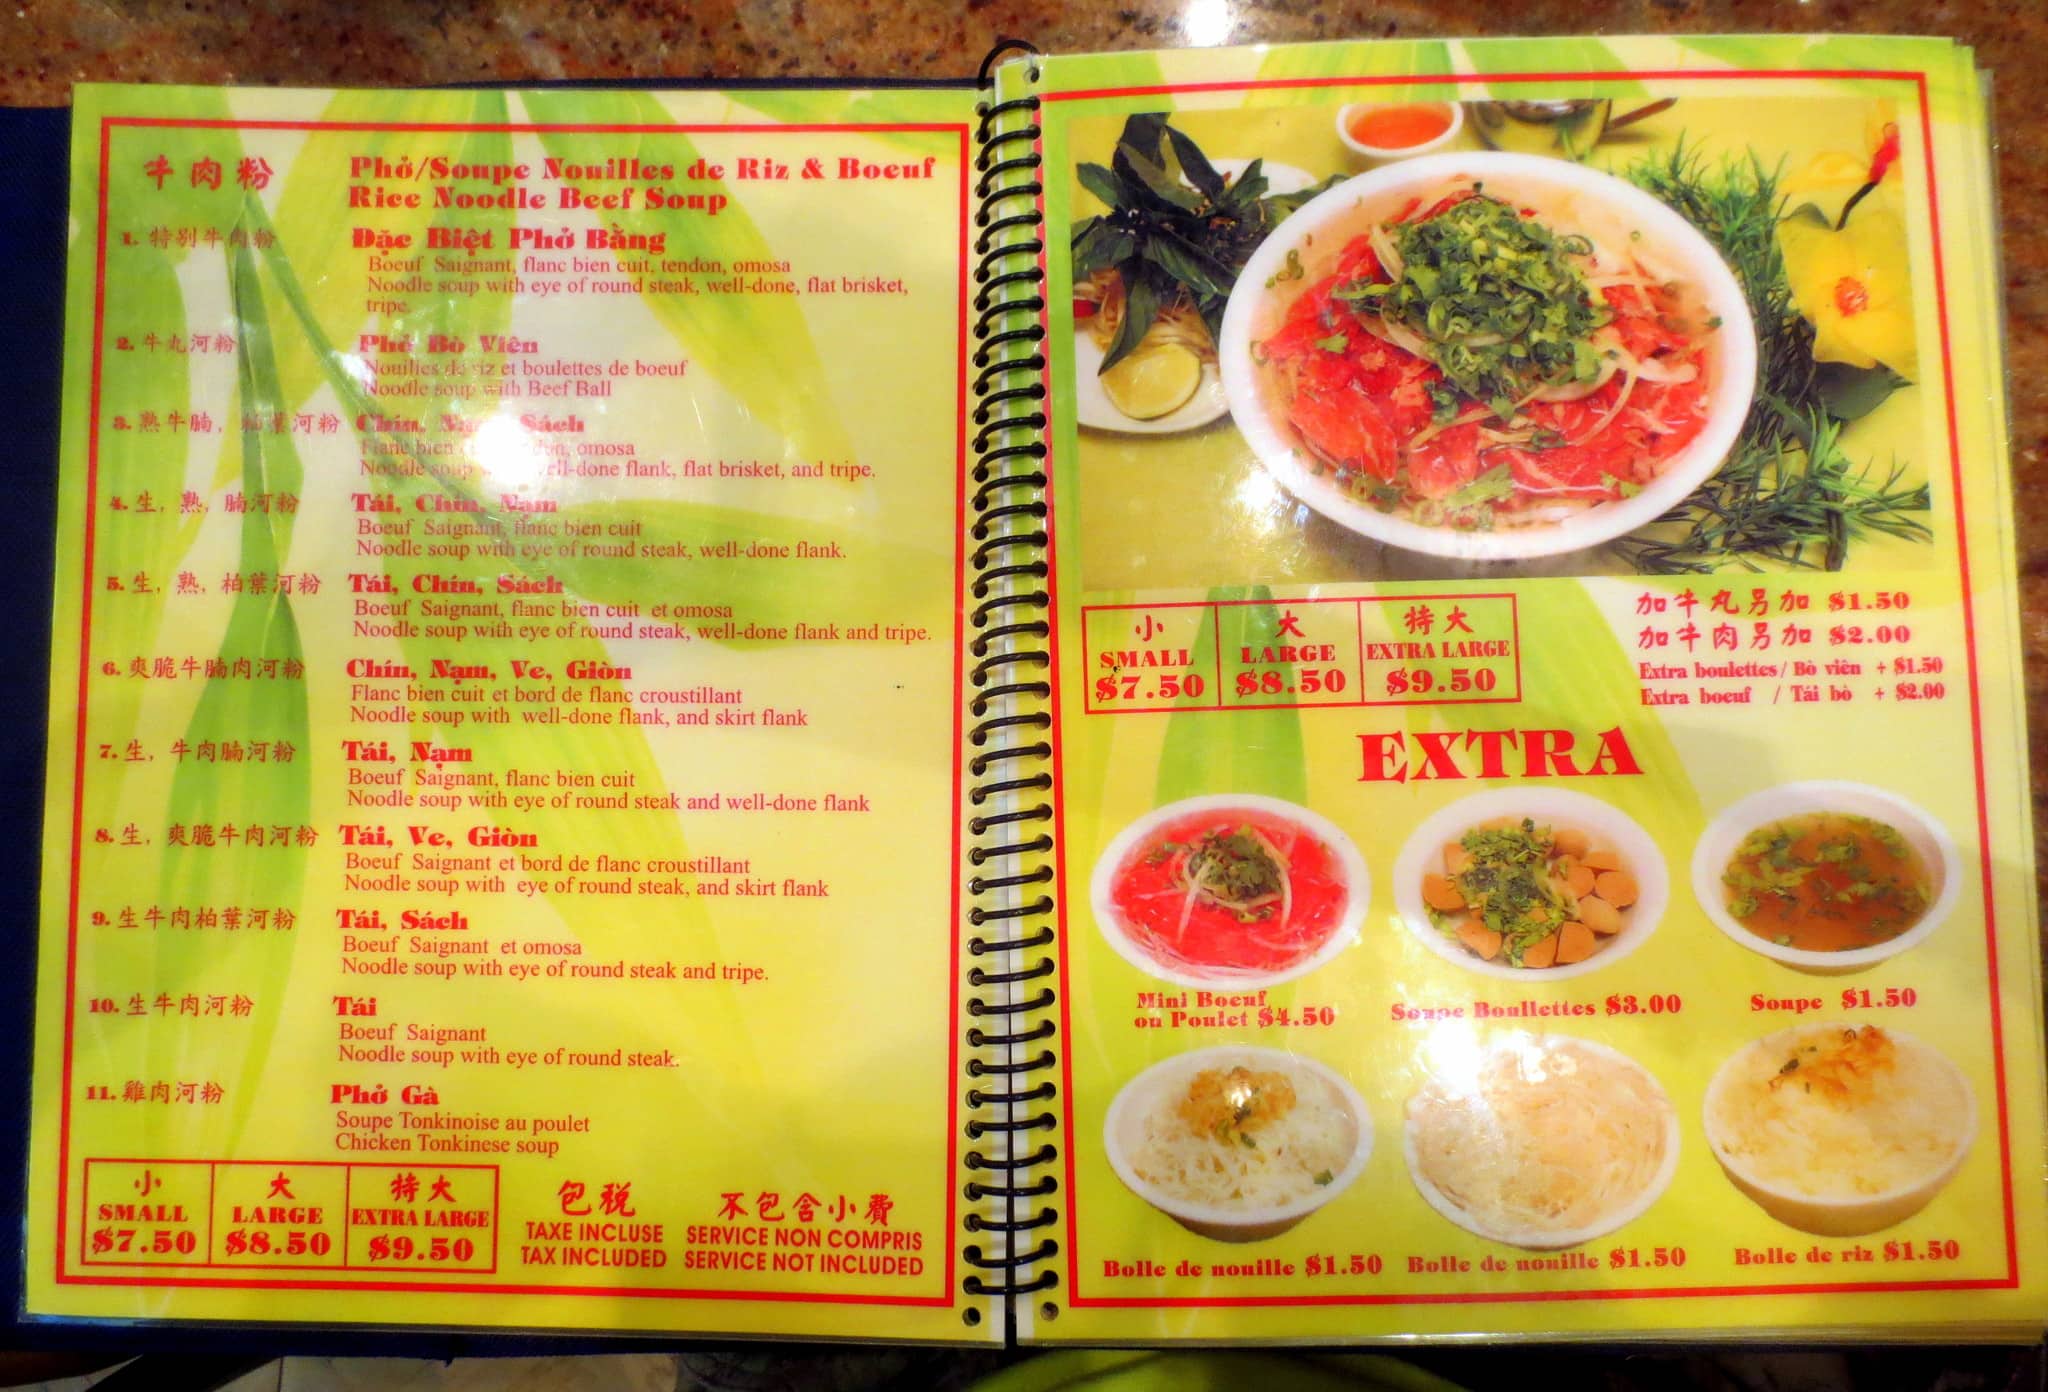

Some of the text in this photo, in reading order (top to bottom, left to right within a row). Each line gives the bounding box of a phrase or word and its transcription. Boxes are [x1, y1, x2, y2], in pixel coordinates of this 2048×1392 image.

[144, 154, 274, 191] 牛肉粉
[542, 157, 674, 181] Nouilles
[688, 158, 725, 180] de
[736, 157, 790, 180] Riz
[801, 158, 824, 179] &
[837, 157, 936, 180] Boeuf
[349, 186, 727, 216] Rice Noodle Beef Soup
[369, 256, 424, 273] Boeuf
[524, 256, 567, 273] flanc
[573, 256, 610, 273] bien
[661, 257, 727, 276] tendon,
[733, 261, 791, 274] omosa
[349, 573, 563, 595] Tái, Chín, Sách
[1828, 591, 1910, 610] $1.50
[1135, 614, 1163, 641] 小
[1275, 610, 1306, 638] 大
[1829, 625, 1911, 645] $2.00
[1100, 648, 1194, 669] SMALL
[1241, 645, 1336, 664] LARGE
[1367, 639, 1510, 661] EXTRA LARGE
[347, 659, 417, 680] Chín,
[1639, 661, 1689, 680] Extra
[1876, 663, 1886, 675] +
[1894, 656, 1943, 675] $1.50
[1096, 672, 1204, 702] $7.50
[1235, 668, 1346, 697] $8.50
[1387, 667, 1496, 696] $9.50
[1641, 686, 1690, 706] Extra
[1700, 685, 1752, 705] boeuf
[1791, 684, 1820, 702] Tái
[1875, 687, 1885, 699] +
[1895, 681, 1946, 701] $2.00
[342, 740, 472, 770] Tái, Nạm
[1357, 725, 1644, 783] EXTRA
[349, 767, 635, 790] Boeuf Saignant, flanc bien cuit
[339, 825, 538, 848] Tái, Ve, Giòn
[336, 909, 469, 931] Tái, Sách
[333, 996, 377, 1017] Tái
[1136, 990, 1268, 1009] Mini Boeuf
[1474, 1001, 1596, 1018] Boullettes
[1605, 994, 1682, 1016] $3.00
[1750, 987, 1917, 1013] Soupe $1.50
[1134, 1006, 1336, 1029] ou Poulet $4.50
[339, 1023, 487, 1045] Boeuf Saignant
[339, 1045, 680, 1069] Noodle soup with eye of round steak.
[401, 1085, 439, 1105] Gà
[336, 1111, 590, 1136] Soupe Tonkinoise au poulet
[336, 1133, 560, 1158] Chicken Tonkinese soup
[134, 1169, 162, 1197] 小
[267, 1171, 296, 1200] 大
[98, 1204, 188, 1222] SMALL
[232, 1206, 323, 1225] LARGE
[352, 1208, 490, 1228] EXTRA LARGE
[92, 1226, 197, 1255] $7.50
[225, 1228, 331, 1257] $8.50
[527, 1222, 664, 1243] TAXE INCLUSE
[687, 1225, 923, 1251] SERVICE NON COMPRIS
[368, 1234, 474, 1263] $9.50
[521, 1245, 667, 1268] TAX INCLUDED
[1407, 1247, 1686, 1274] Bolle de nouille $1.50
[1735, 1239, 1960, 1265] Bolle de riz $1.50
[684, 1250, 924, 1276] SERVICE NOT INCLUDED
[1103, 1254, 1383, 1277] Bolle de nouille $1.50
